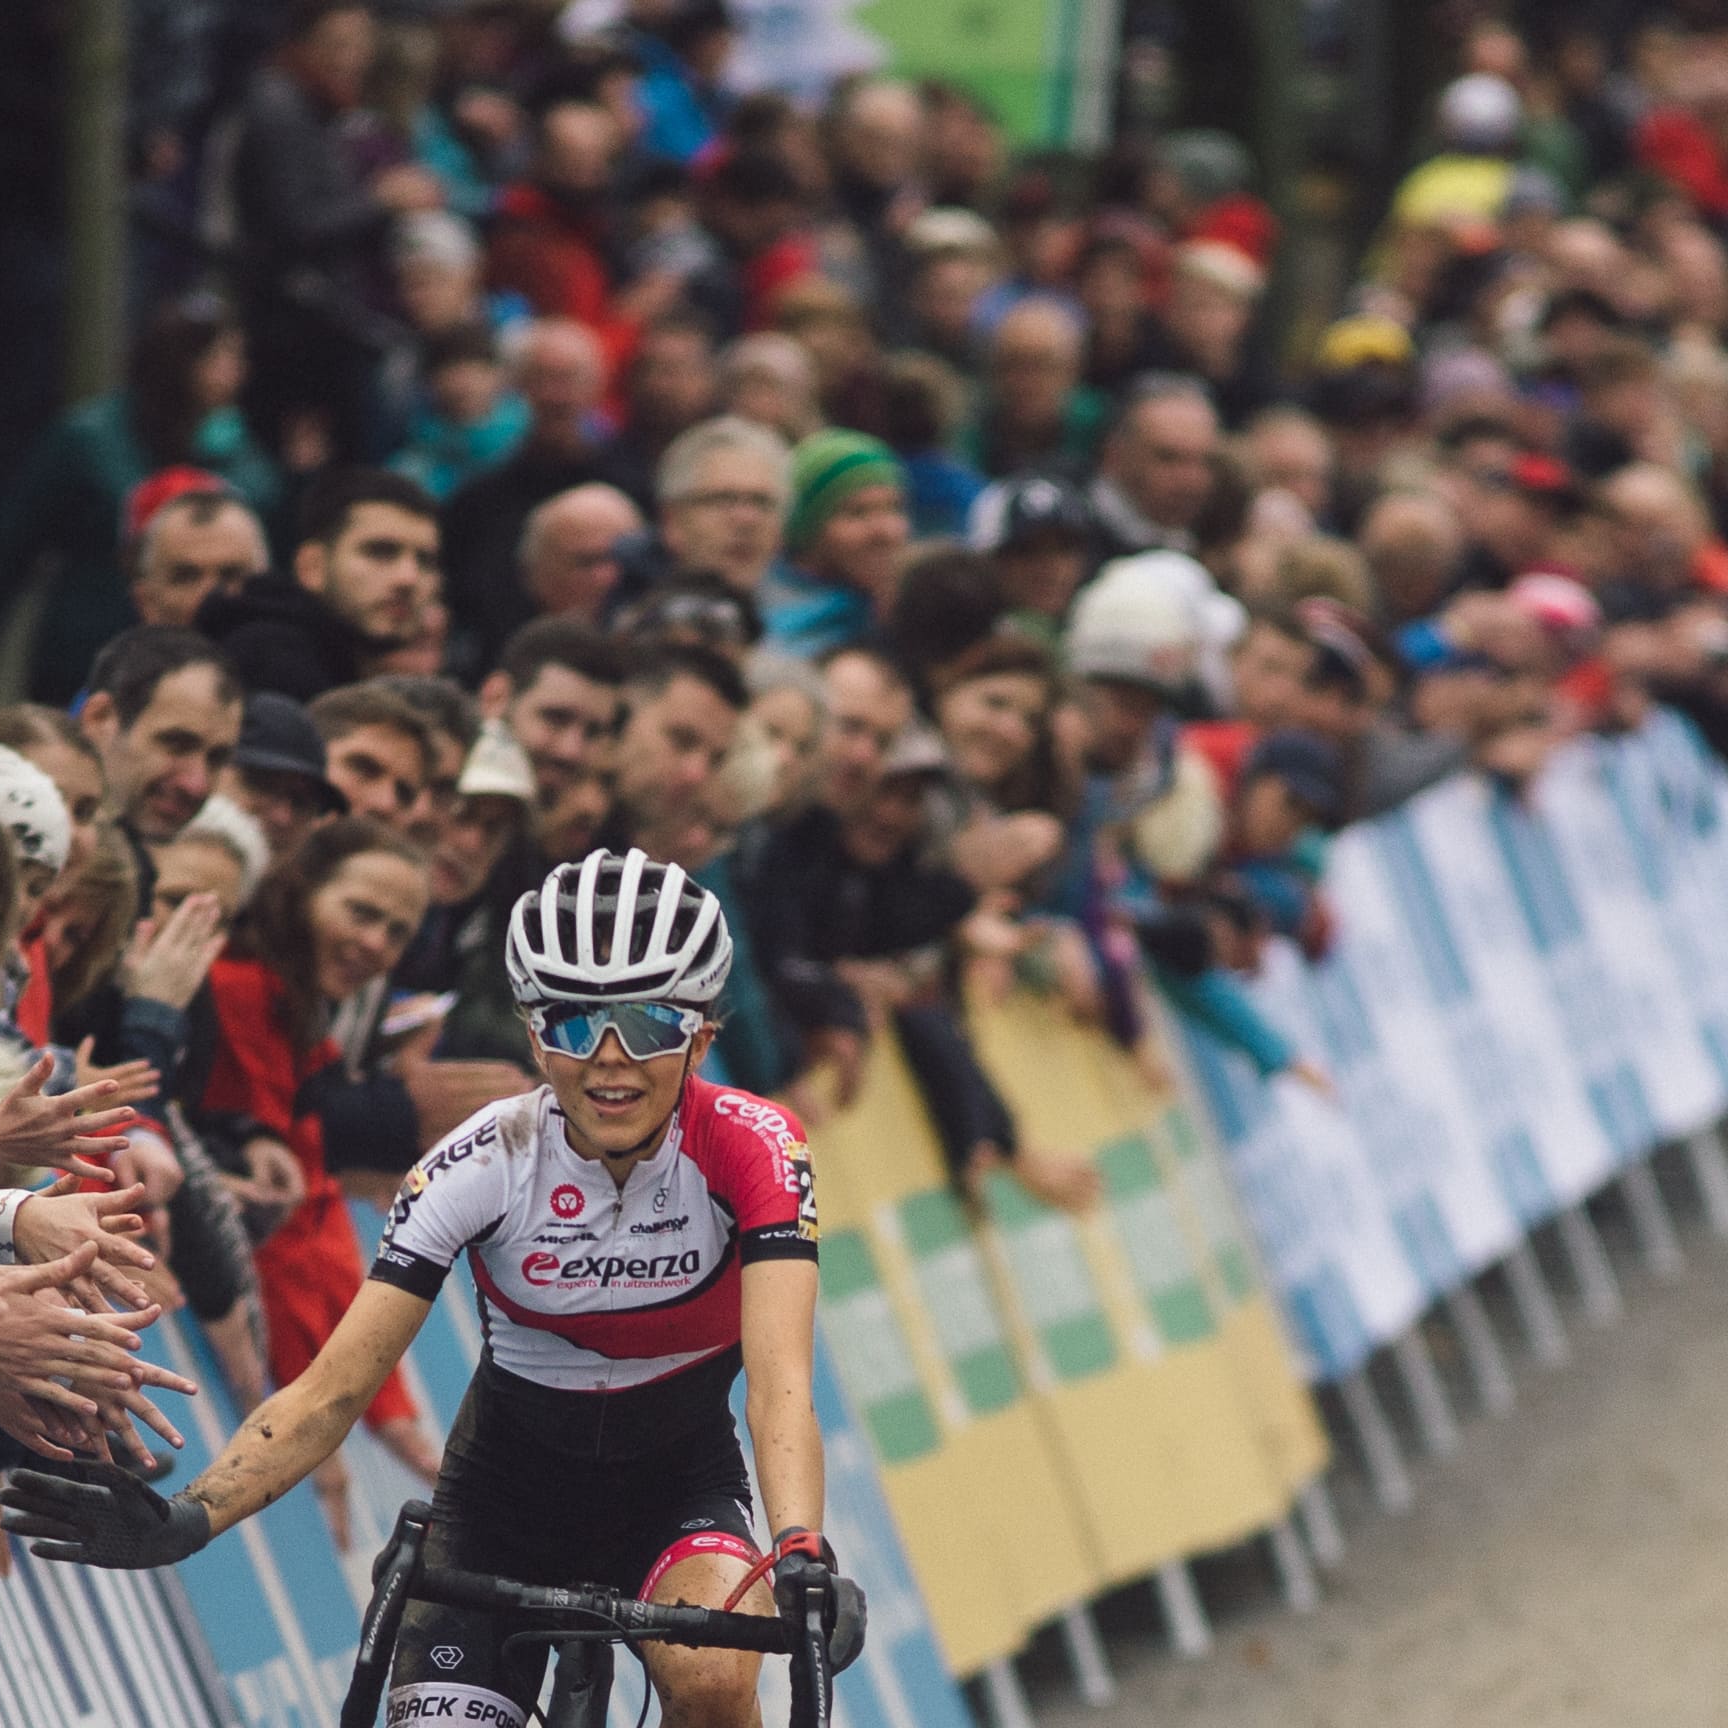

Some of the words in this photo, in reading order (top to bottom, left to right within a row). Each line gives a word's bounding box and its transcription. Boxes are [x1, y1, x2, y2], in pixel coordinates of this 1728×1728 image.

[560, 1249, 700, 1288] experza
[556, 1279, 598, 1290] experts
[610, 1279, 620, 1288] in
[623, 1276, 692, 1289] uitzendwerk
